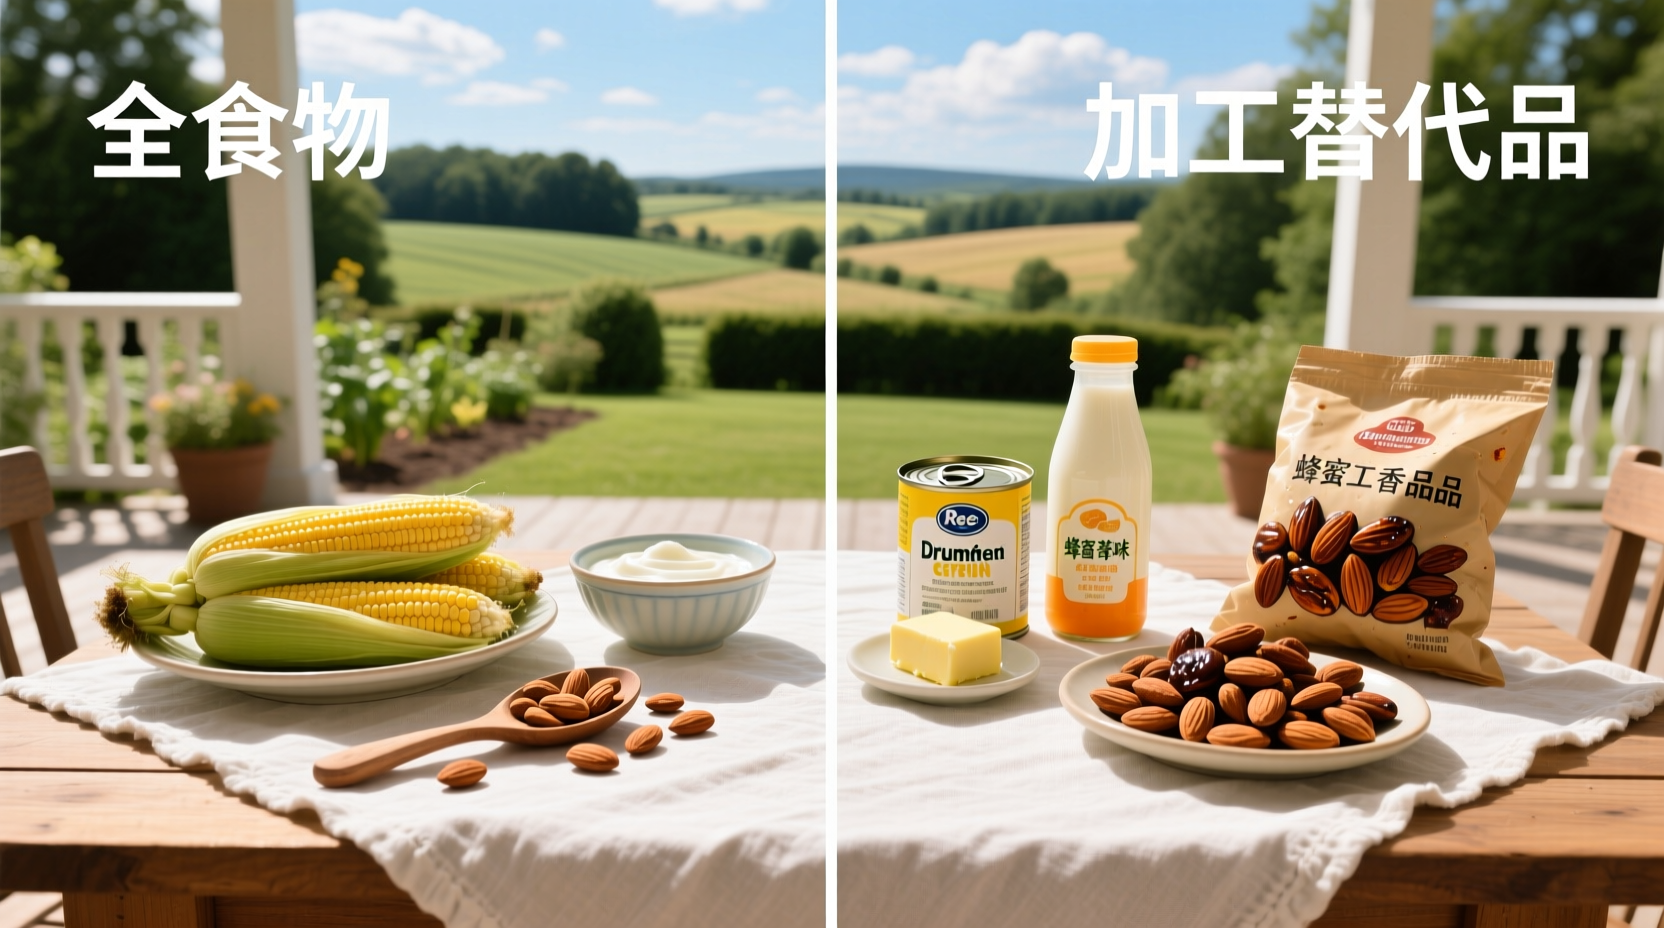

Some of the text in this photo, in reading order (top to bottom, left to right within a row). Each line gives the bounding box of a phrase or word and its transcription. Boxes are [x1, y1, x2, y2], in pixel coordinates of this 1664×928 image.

[1292, 453, 1463, 509] 蜂蜜工香品品
